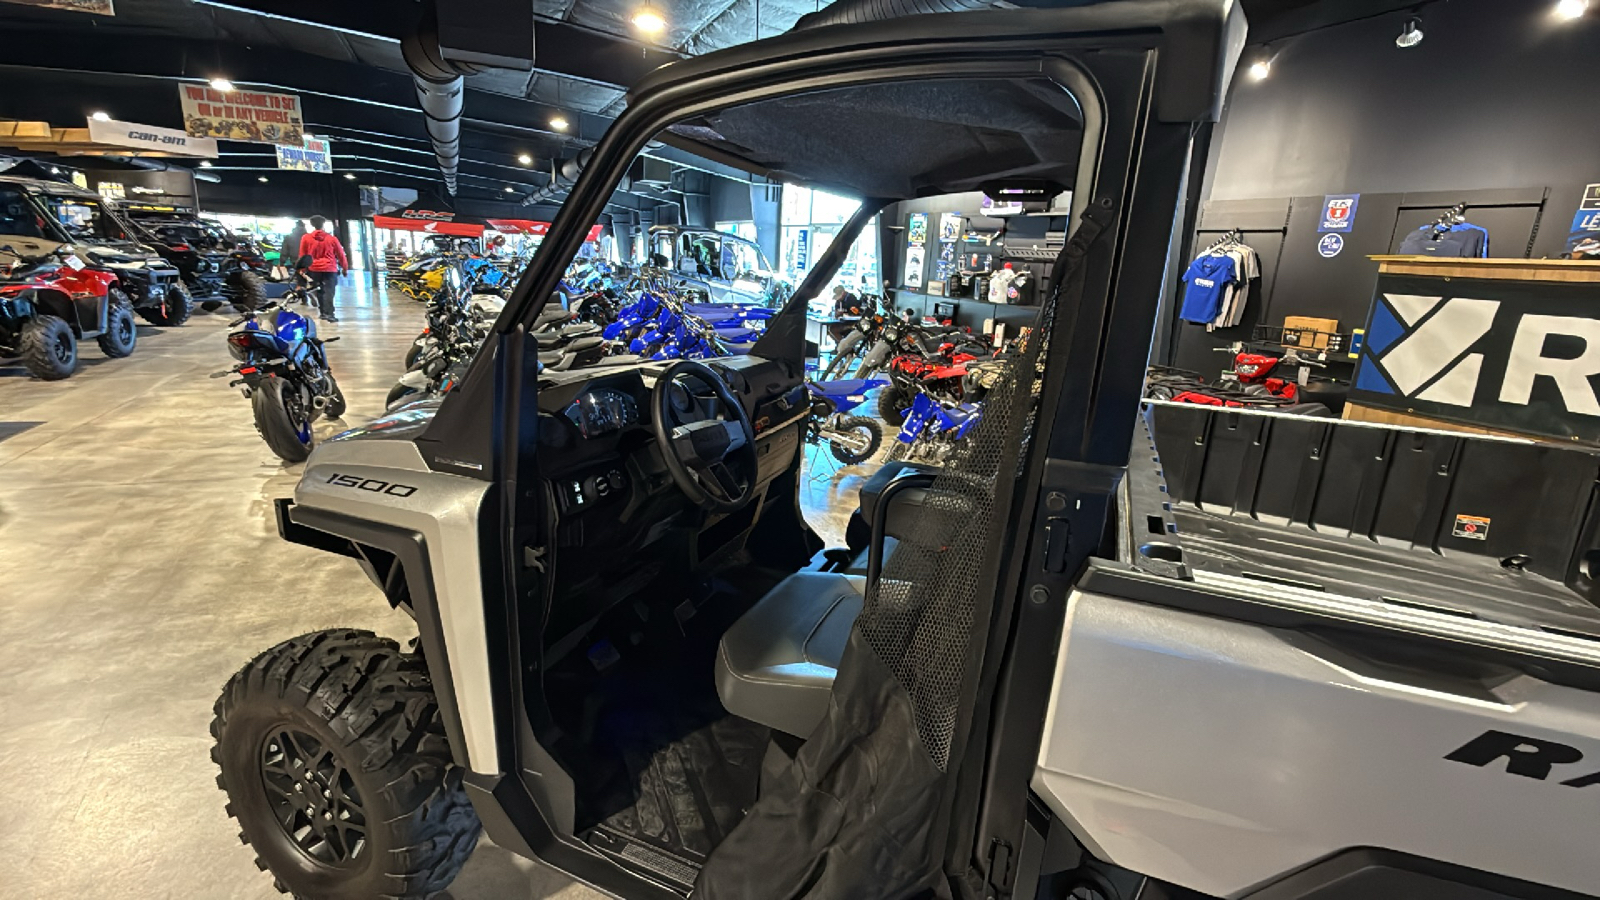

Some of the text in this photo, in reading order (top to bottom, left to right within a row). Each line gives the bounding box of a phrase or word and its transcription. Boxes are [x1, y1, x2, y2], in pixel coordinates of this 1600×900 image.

[281, 96, 296, 111] SIT
[253, 108, 289, 124] VEHICLE
[128, 131, 186, 146] can-am
[326, 473, 418, 498] 1500
